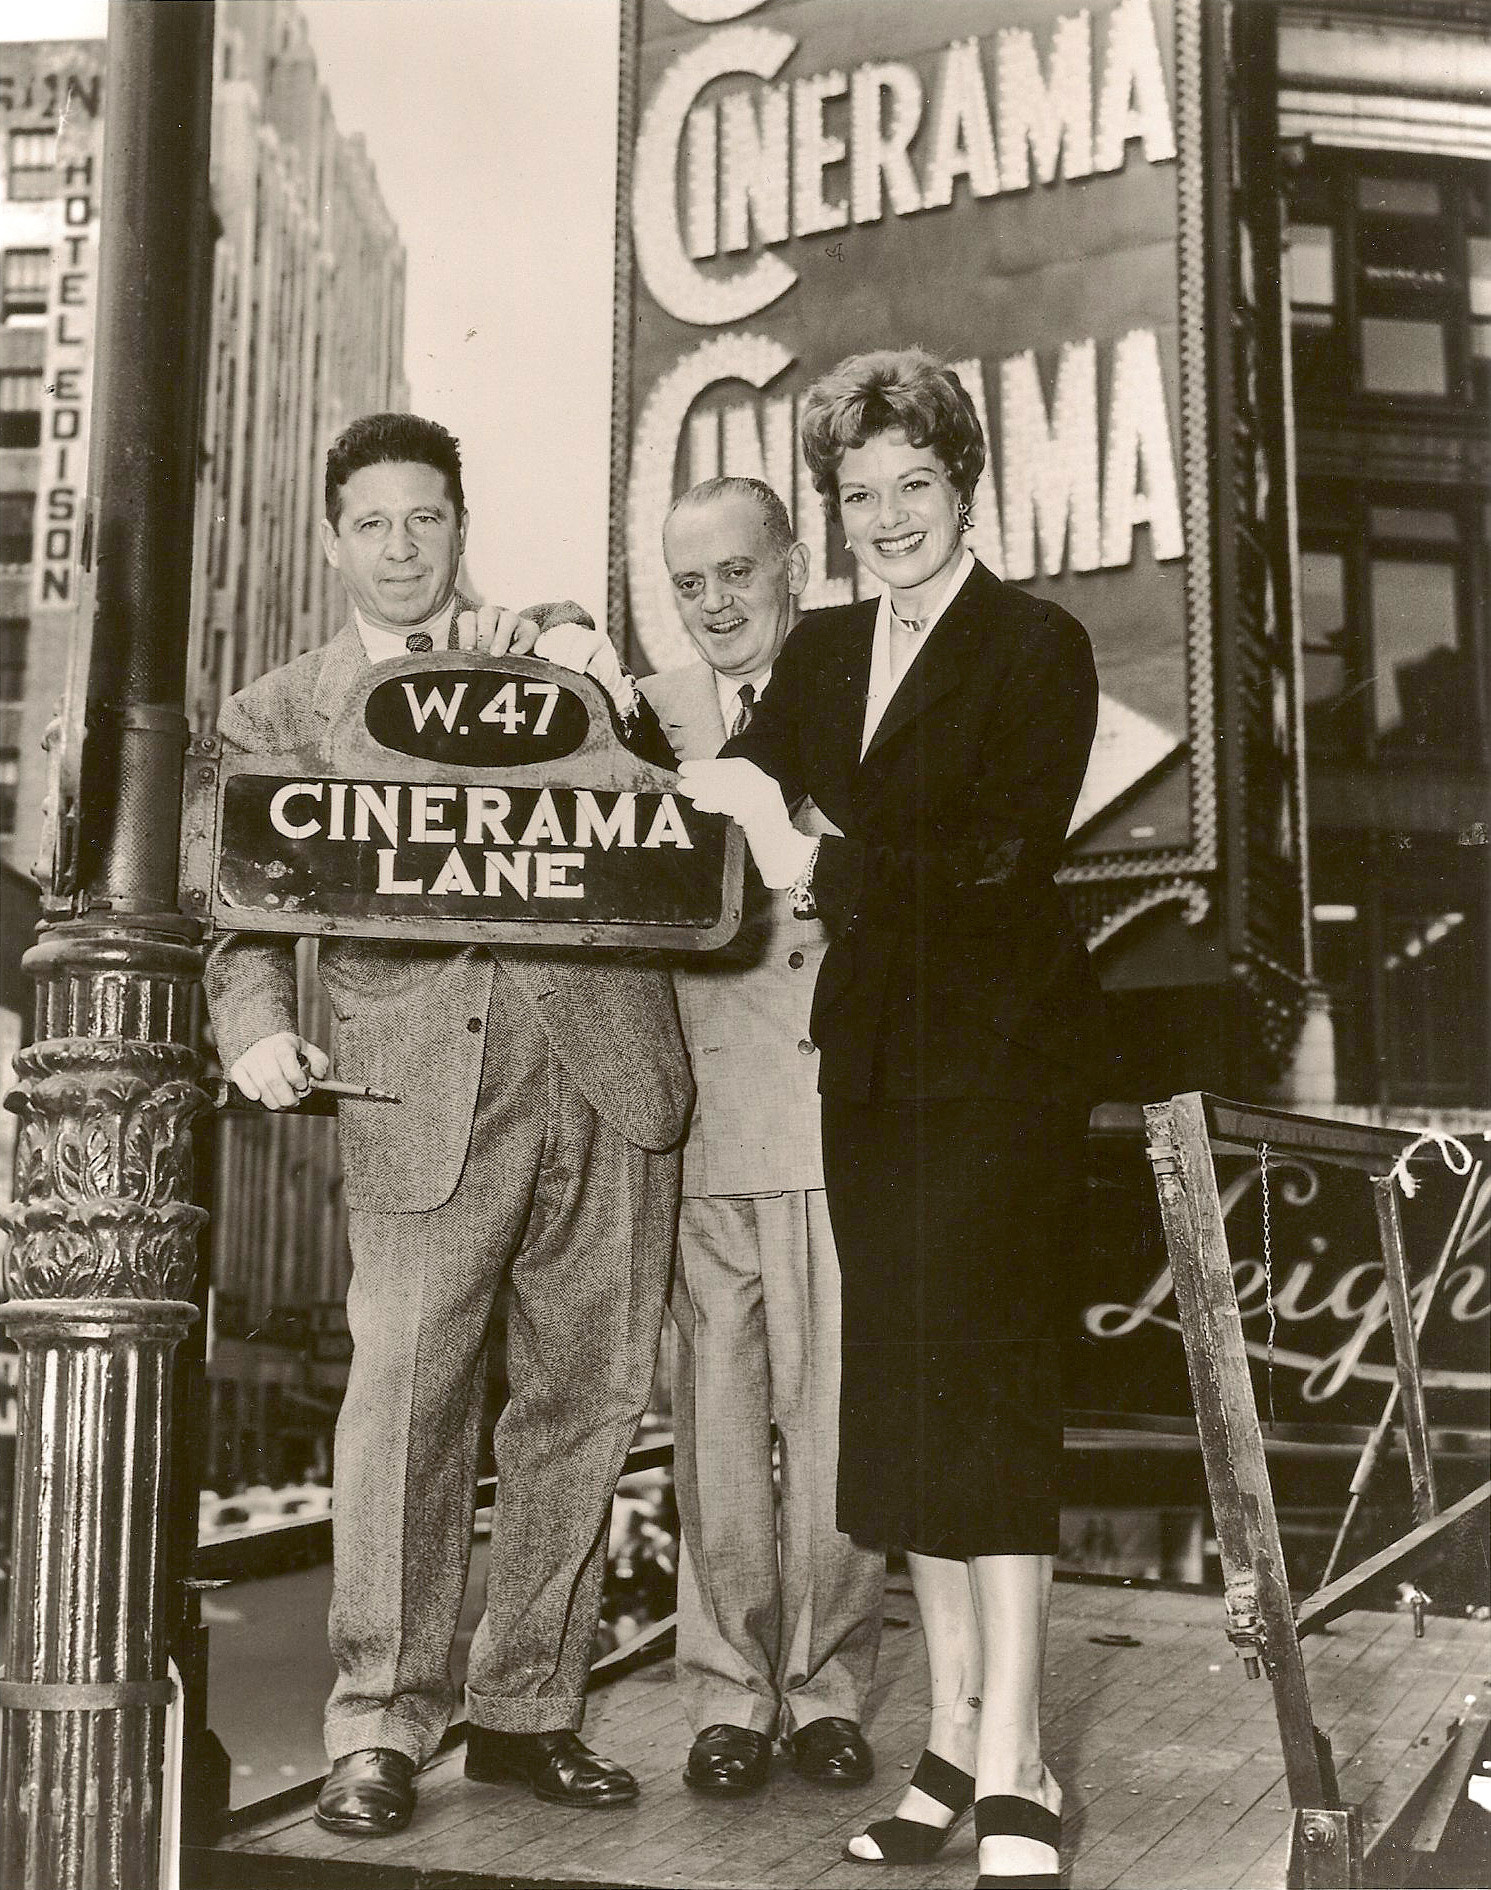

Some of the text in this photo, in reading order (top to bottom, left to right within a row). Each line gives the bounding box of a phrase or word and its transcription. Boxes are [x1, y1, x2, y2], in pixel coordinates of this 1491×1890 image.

[632, 0, 1178, 325] CINERAMA
[42, 156, 93, 601] HOTEL EDISON
[402, 682, 560, 736] W. 47
[269, 782, 695, 851] CINERAMA
[375, 846, 586, 901] LANE
